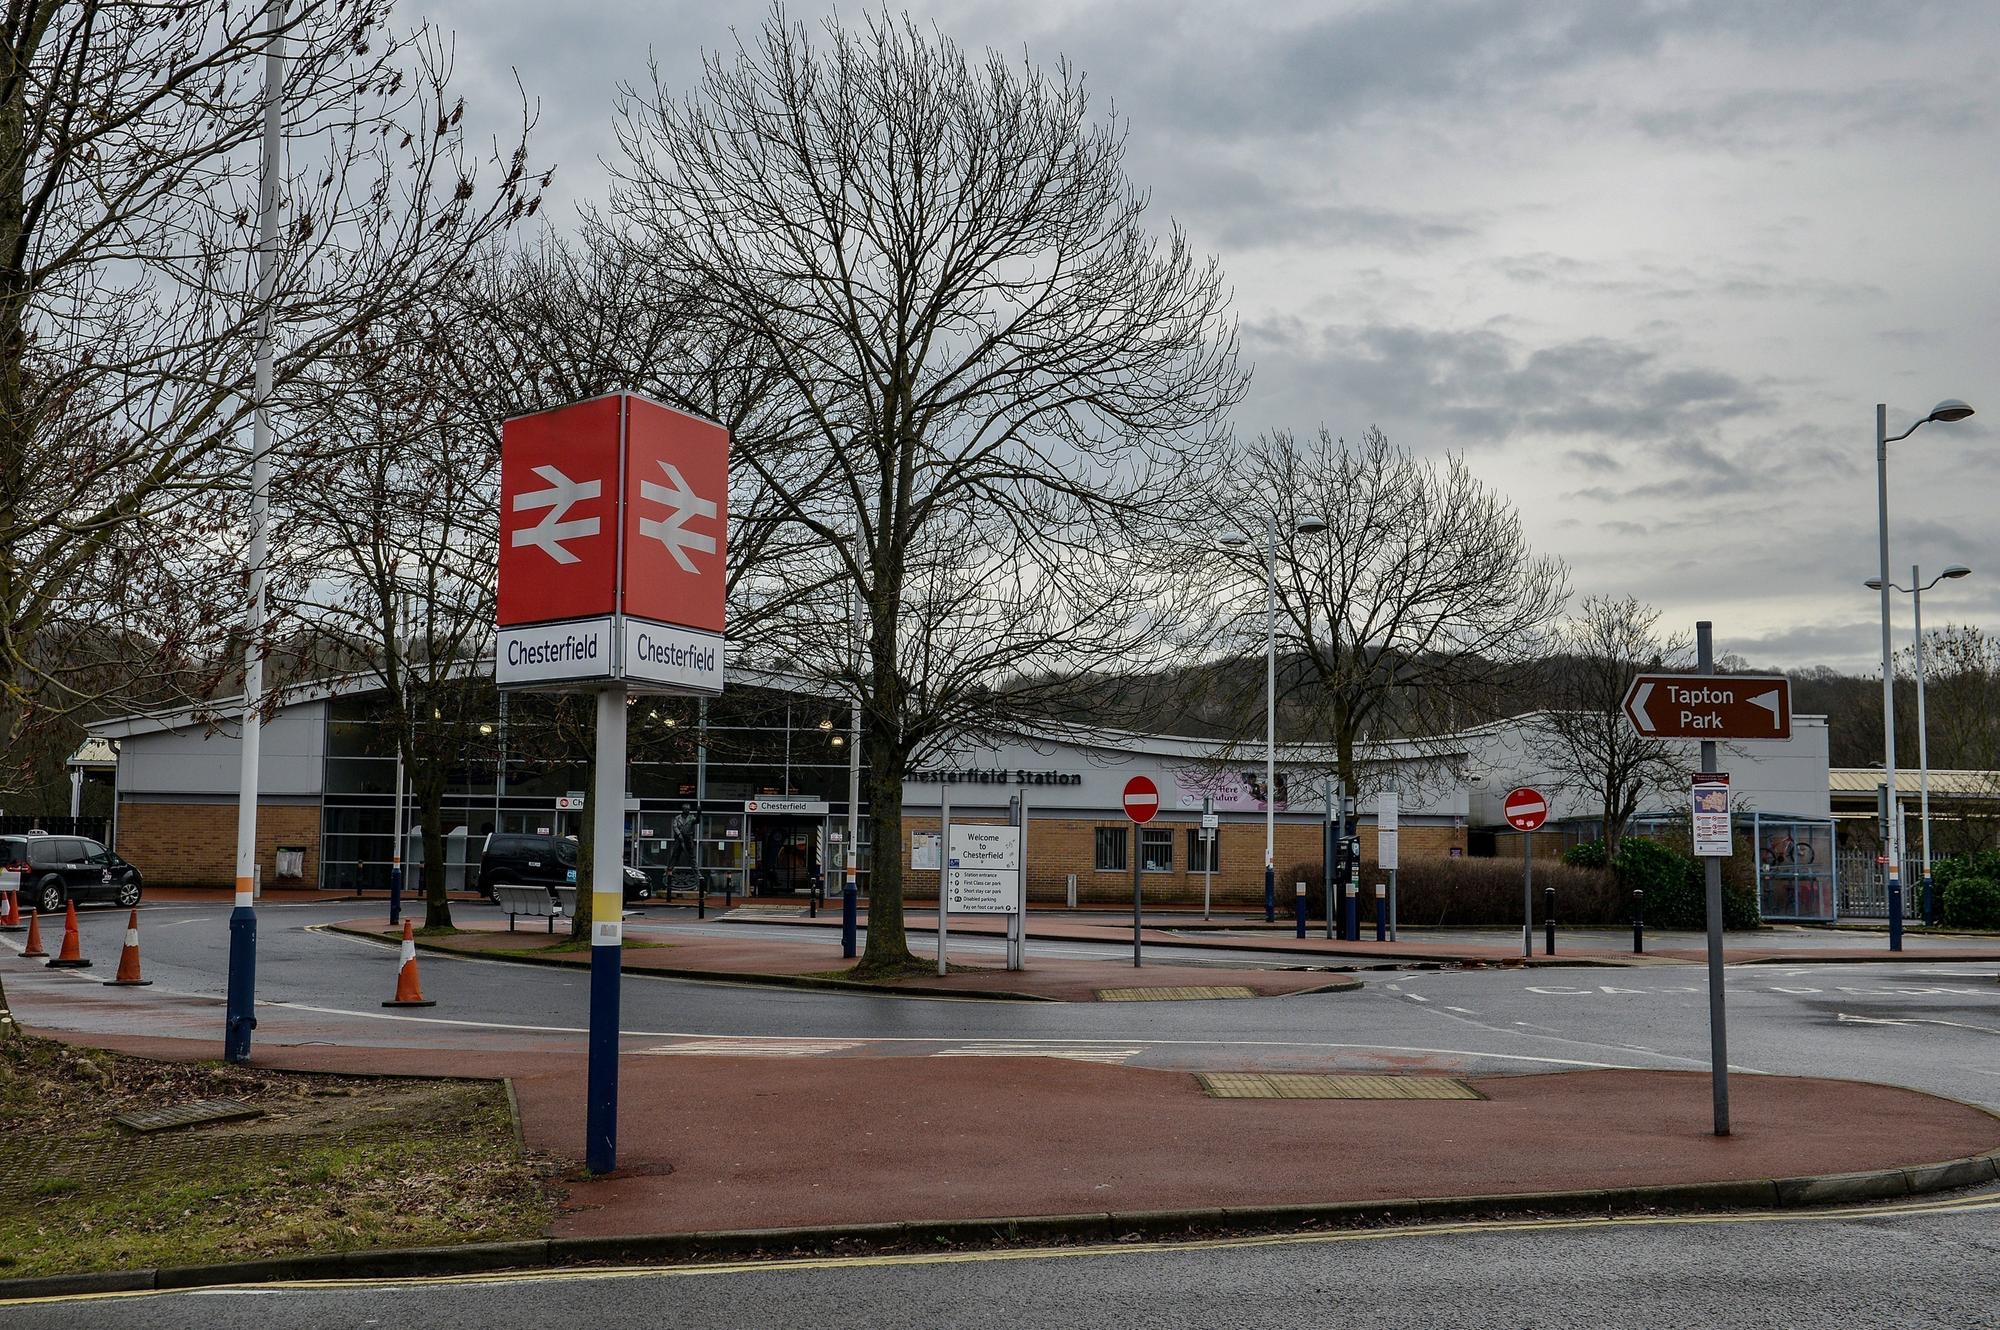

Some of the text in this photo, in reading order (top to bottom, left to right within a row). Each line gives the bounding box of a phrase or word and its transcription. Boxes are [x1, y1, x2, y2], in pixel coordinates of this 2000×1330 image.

[508, 633, 598, 666] Chesterfield
[637, 633, 715, 672] Chesterfield
[1667, 685, 1734, 709] Tapton
[1680, 711, 1724, 730] Park
[902, 768, 1082, 785] hesterfield Station
[761, 802, 807, 810] Chesterfield
[967, 833, 1000, 842] Welcome
[962, 851, 1004, 859] Chesterfield
